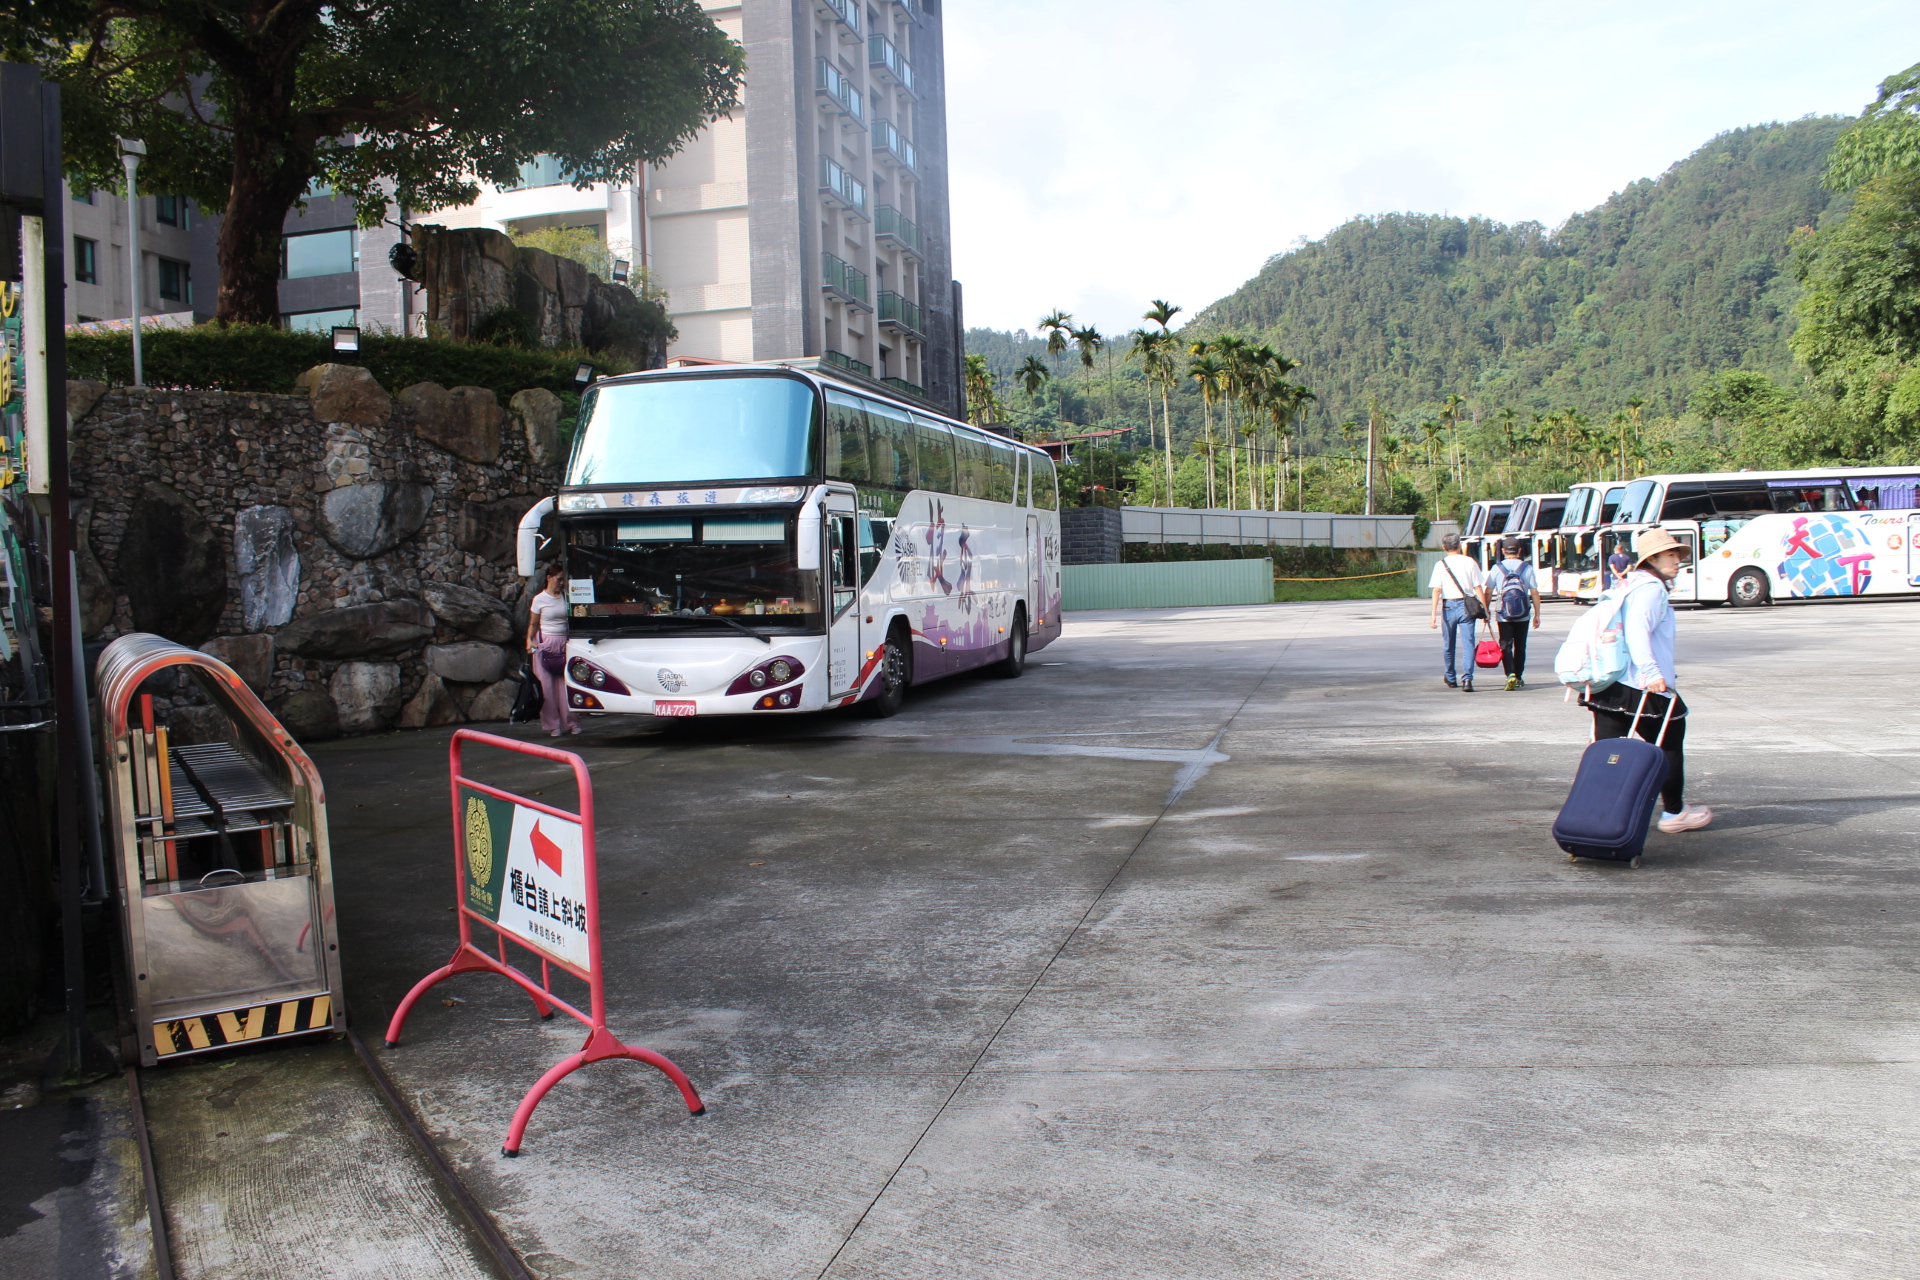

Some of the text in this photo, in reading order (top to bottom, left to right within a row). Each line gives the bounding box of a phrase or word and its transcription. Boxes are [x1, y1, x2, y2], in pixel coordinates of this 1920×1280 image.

[621, 490, 718, 507] 捷森旅遊
[1859, 513, 1905, 526] Tours
[1785, 516, 1875, 596] 天下
[655, 704, 696, 717] KAA-7278
[510, 867, 587, 934] 櫃台請上斜坡
